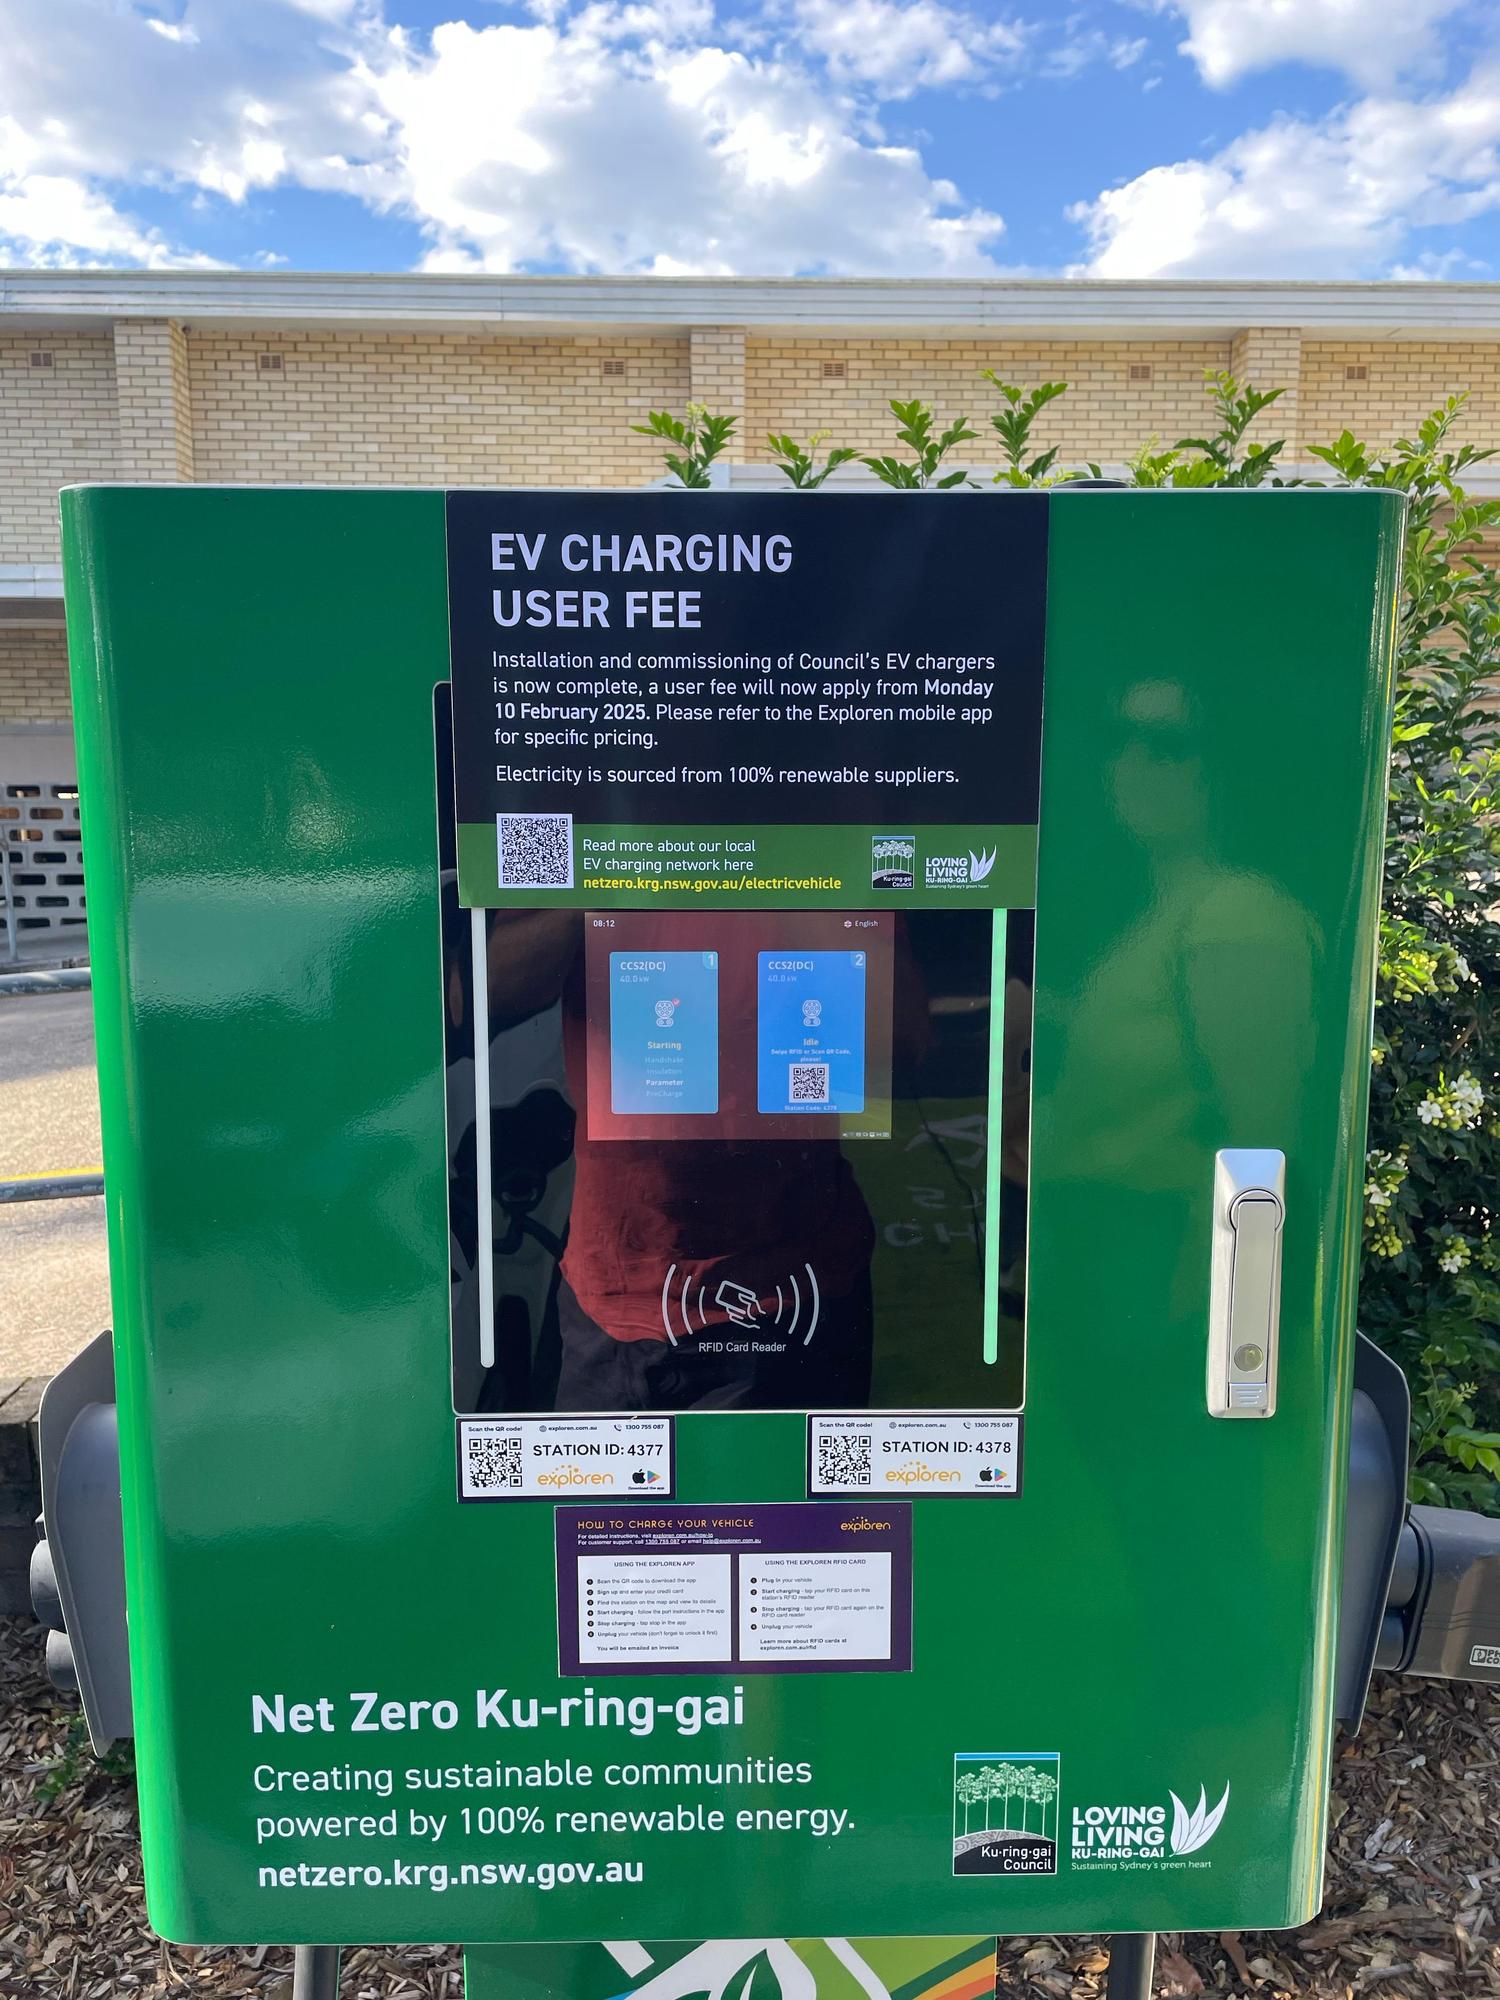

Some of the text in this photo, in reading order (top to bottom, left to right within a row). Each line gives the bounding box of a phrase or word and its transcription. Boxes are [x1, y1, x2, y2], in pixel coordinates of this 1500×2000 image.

[492, 533, 792, 572] EV CHARGING
[493, 590, 701, 627] USER FEE
[493, 651, 994, 673] Installation and commissioning of Council's EV chargers
[494, 677, 993, 698] is now complete, a user fee will now apply from Monday
[496, 703, 992, 724] 10 February 2025. Please refer to the Exploren mobile app
[495, 728, 657, 749] for specific pricing.
[497, 766, 958, 786] Electricity is sourced from 100% renewable suppliers.
[584, 839, 755, 851] Read more about our local
[584, 858, 753, 873] EV charging network here
[926, 858, 967, 866] LOVING
[926, 868, 967, 877] LIVING
[584, 876, 841, 892] netzero.krg.nsw.gov.au/electricvehicle
[593, 920, 615, 928] 08:12
[855, 920, 878, 928] English
[620, 961, 666, 972] CCS2(DC)
[708, 954, 714, 966] 1
[768, 961, 814, 971] CCS2(DC)
[856, 954, 863, 966] 2
[647, 1041, 682, 1051] Starting
[803, 1038, 819, 1046] Idle
[699, 1342, 786, 1352] RFID Card Reader
[534, 1444, 663, 1456] STATION ID: 4377
[883, 1442, 1010, 1453] STATION ID: 4378
[537, 1468, 614, 1489] exploren
[886, 1465, 960, 1485] exploren
[578, 1521, 604, 1529] HOW
[629, 1520, 672, 1528] CHARGE
[712, 1519, 753, 1527] VEHICLE
[840, 1519, 891, 1533] exploren
[252, 1686, 743, 1735] Net Zero Ku-ring-gai
[254, 1757, 811, 1795] Creating sustainable communities
[1073, 1806, 1165, 1825] LOVING
[257, 1804, 854, 1843] powered by 100% renewable energy.
[1072, 1826, 1164, 1846] LIVING
[1072, 1847, 1164, 1859] KU-RING-GAI
[1004, 1858, 1051, 1870] Council
[1072, 1863, 1117, 1871] Sustaining
[1120, 1862, 1158, 1871] Sydney's
[259, 1859, 642, 1891] netzero.krg.nsw.gov.au
